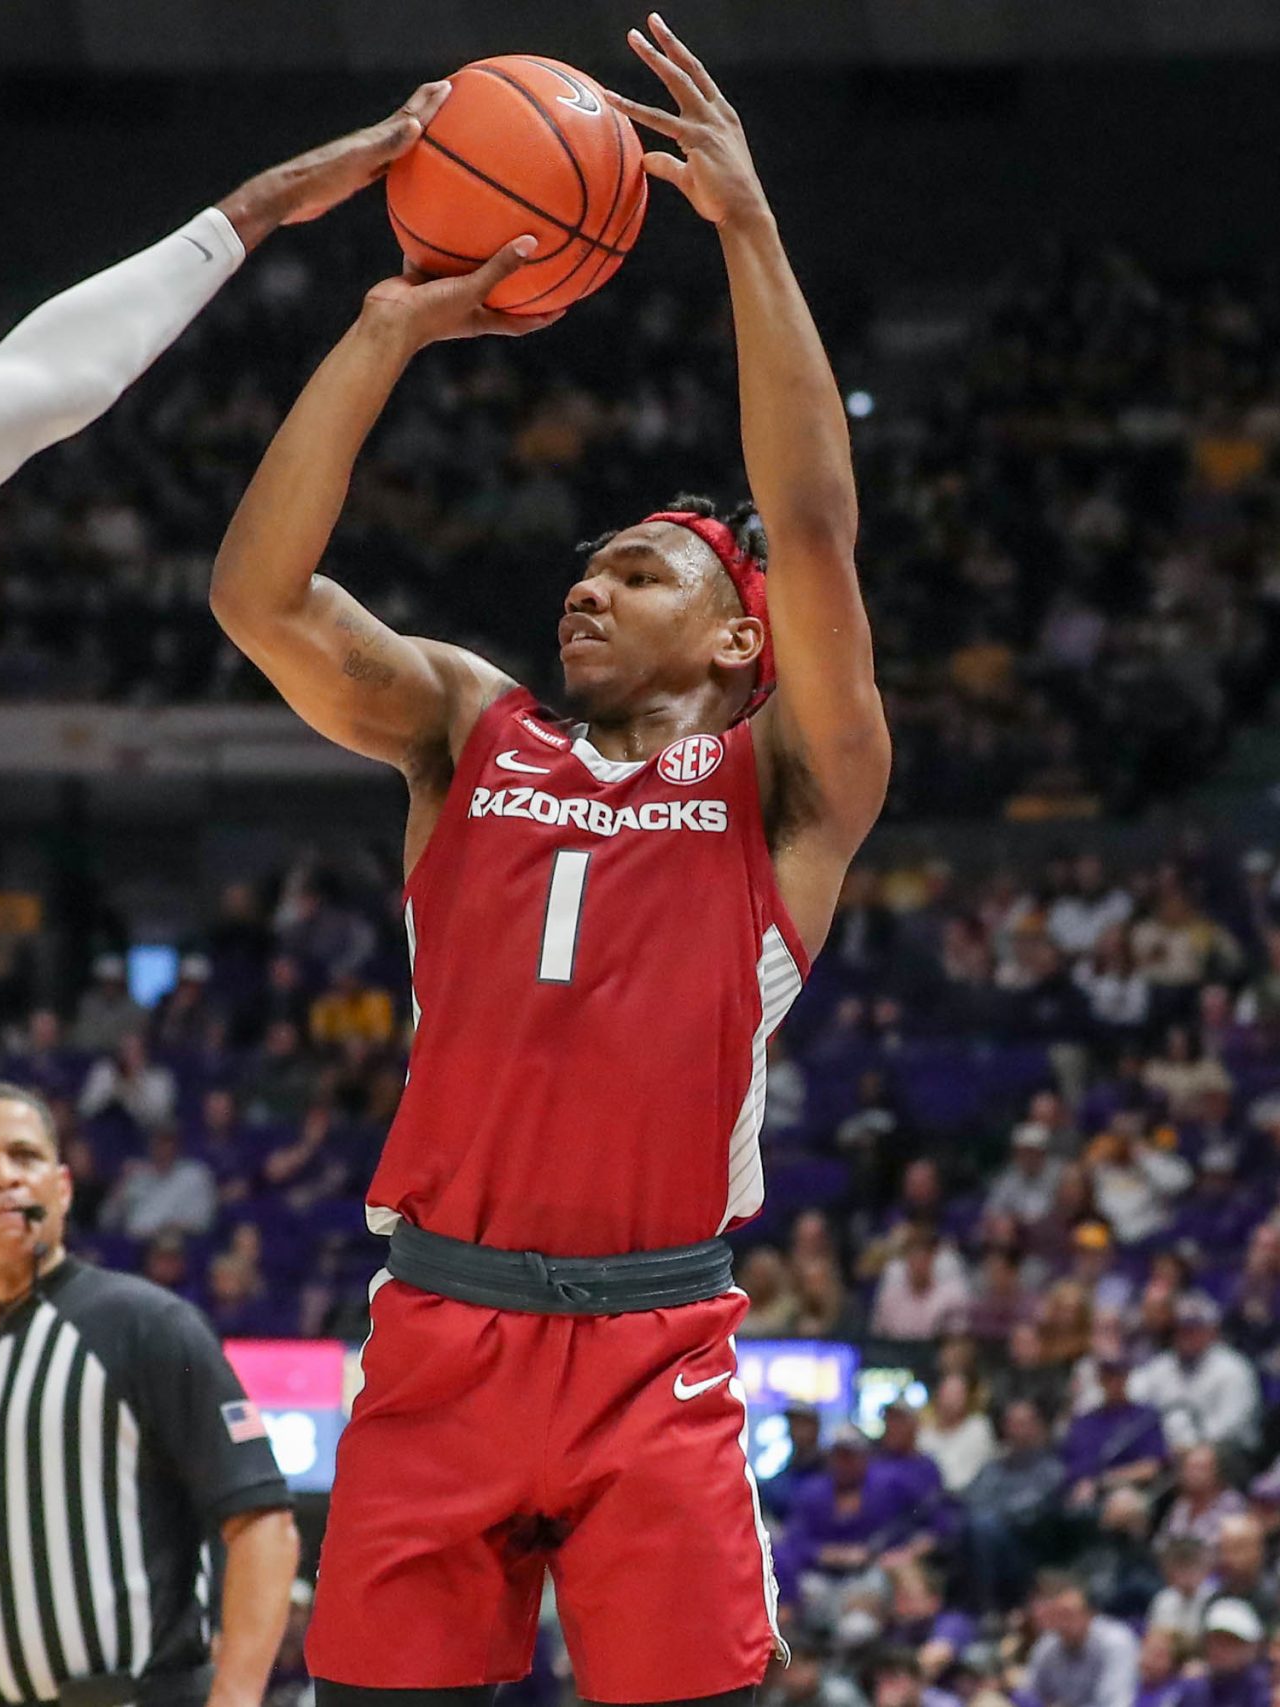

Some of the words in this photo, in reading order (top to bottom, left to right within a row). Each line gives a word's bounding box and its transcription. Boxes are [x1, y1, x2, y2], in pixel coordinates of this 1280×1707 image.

[521, 718, 567, 747] EQUALITY
[662, 736, 719, 781] SEC
[468, 787, 729, 837] RAZORBACKS
[537, 849, 592, 985] 1
